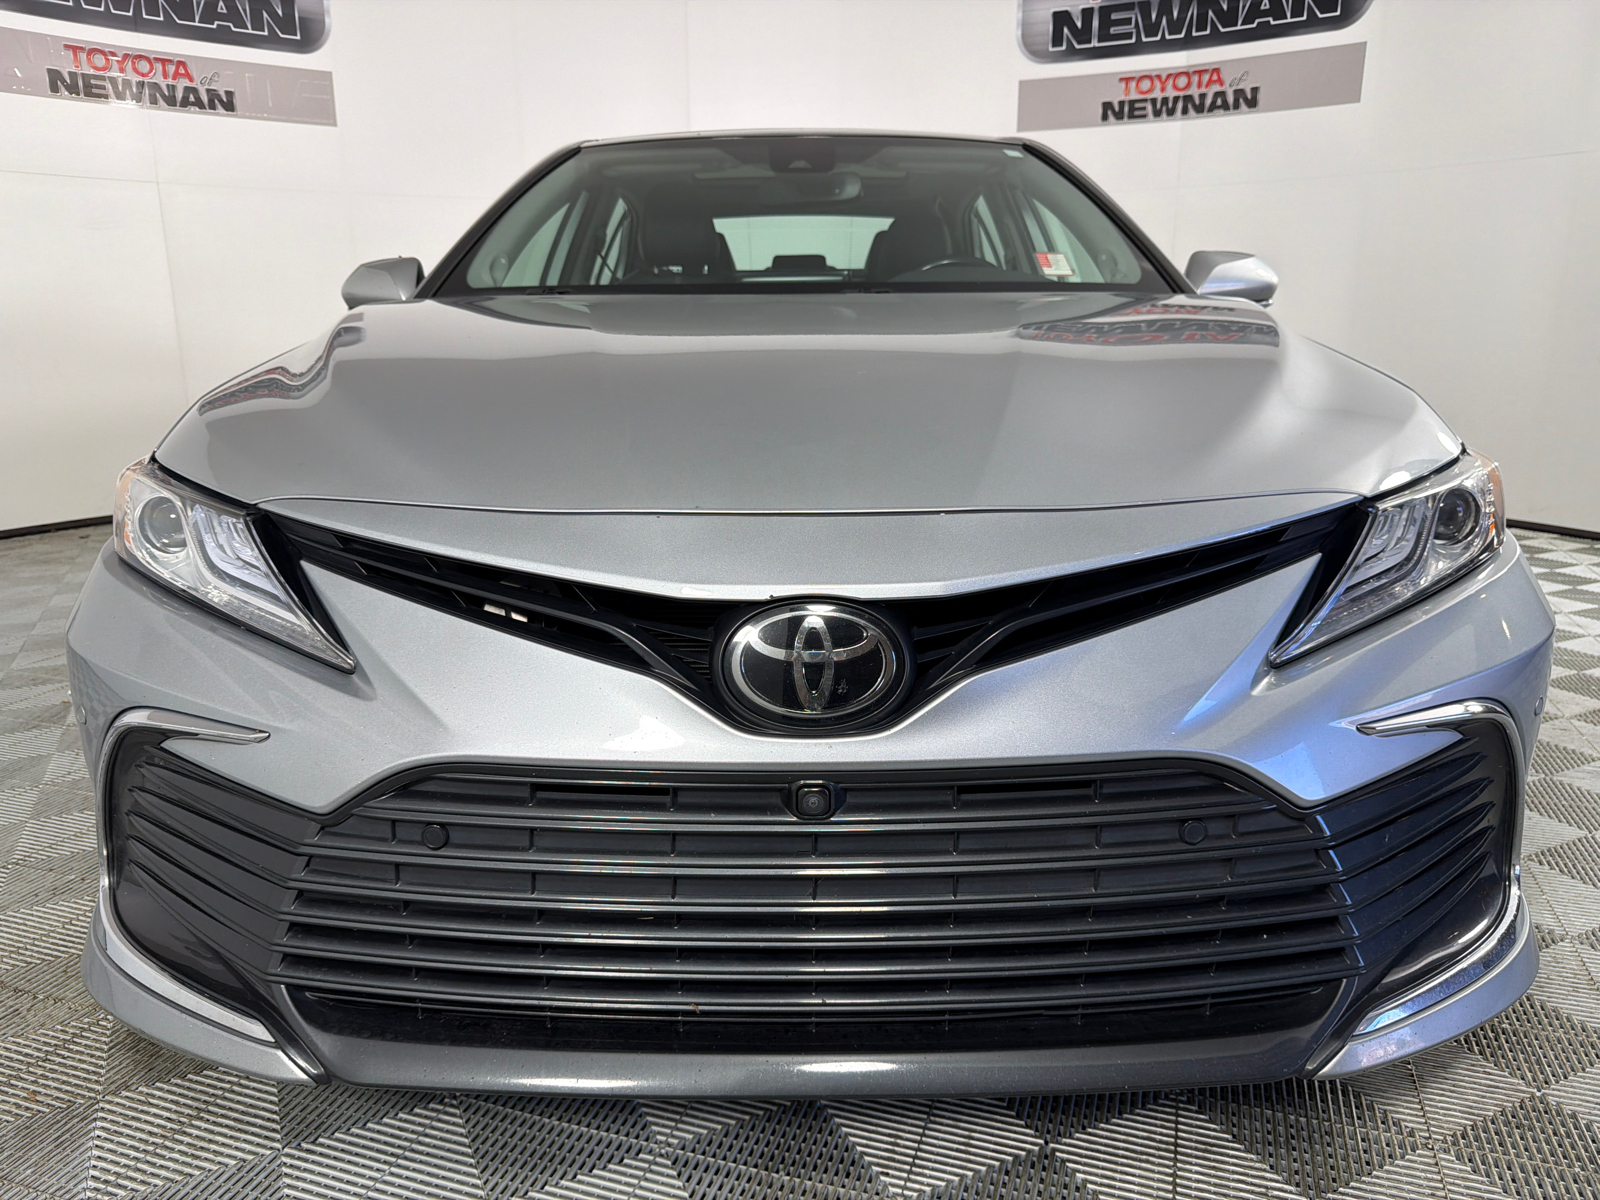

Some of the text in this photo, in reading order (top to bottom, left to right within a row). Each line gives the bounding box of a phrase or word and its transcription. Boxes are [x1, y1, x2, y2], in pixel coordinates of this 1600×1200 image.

[63, 43, 219, 87] TOYOTA of
[1119, 67, 1249, 97] TOYOTA of
[45, 67, 236, 113] NEWNAN
[1101, 86, 1260, 122] NEWNAN
